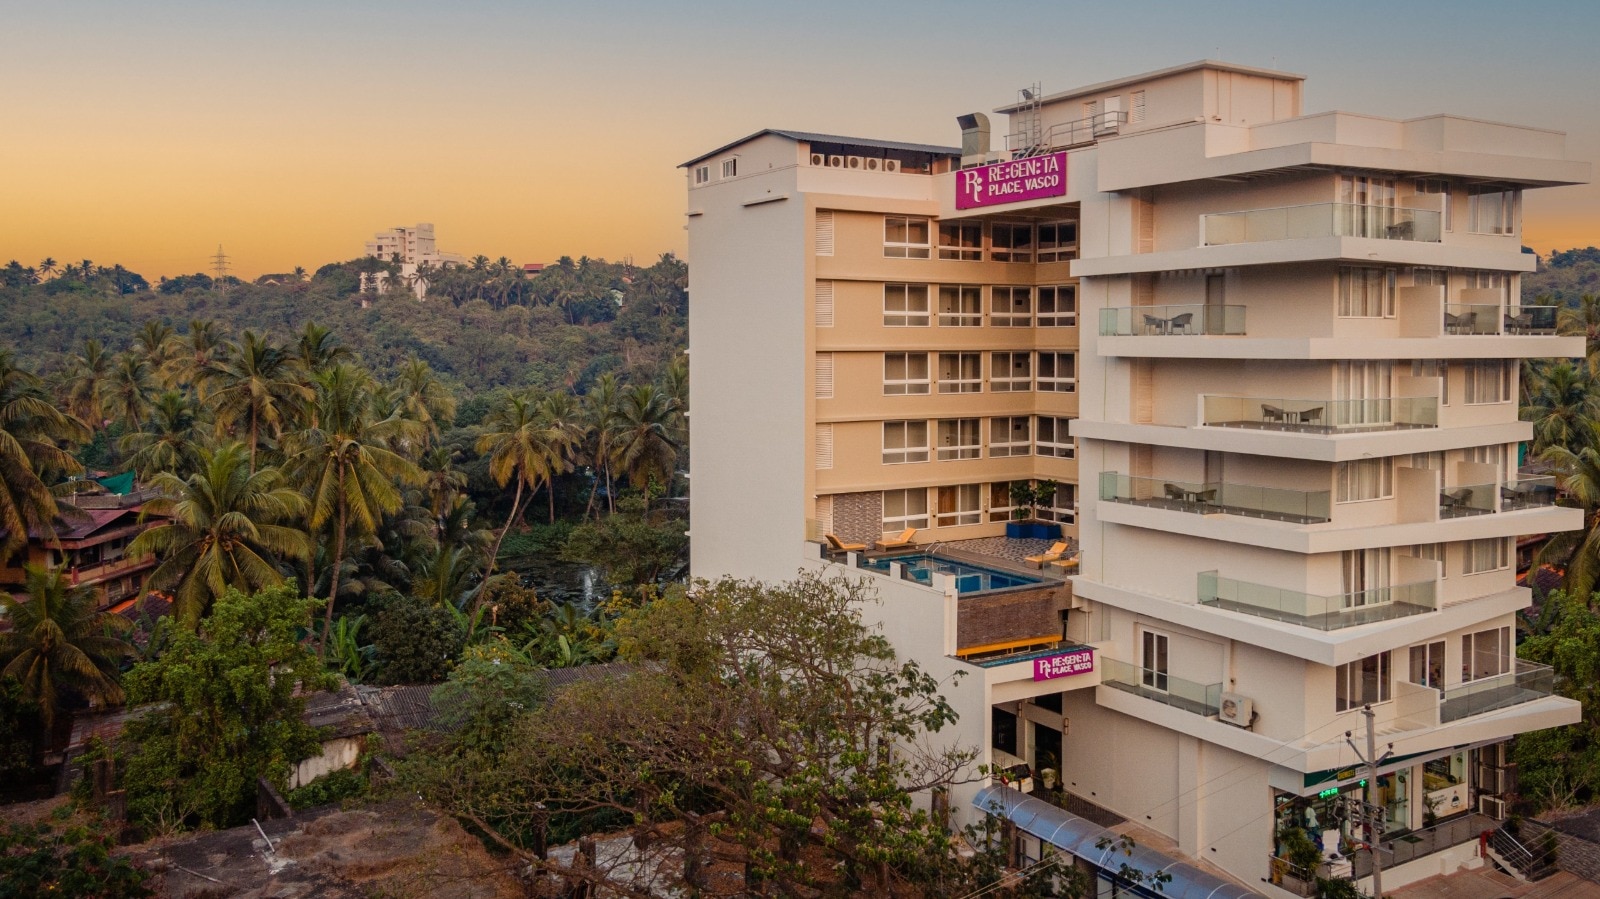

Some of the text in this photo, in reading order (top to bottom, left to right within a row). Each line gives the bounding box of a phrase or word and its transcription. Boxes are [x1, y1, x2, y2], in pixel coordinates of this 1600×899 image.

[989, 175, 1059, 196] PLACE, VASCO
[1052, 662, 1091, 675] PLACE, VASCO
